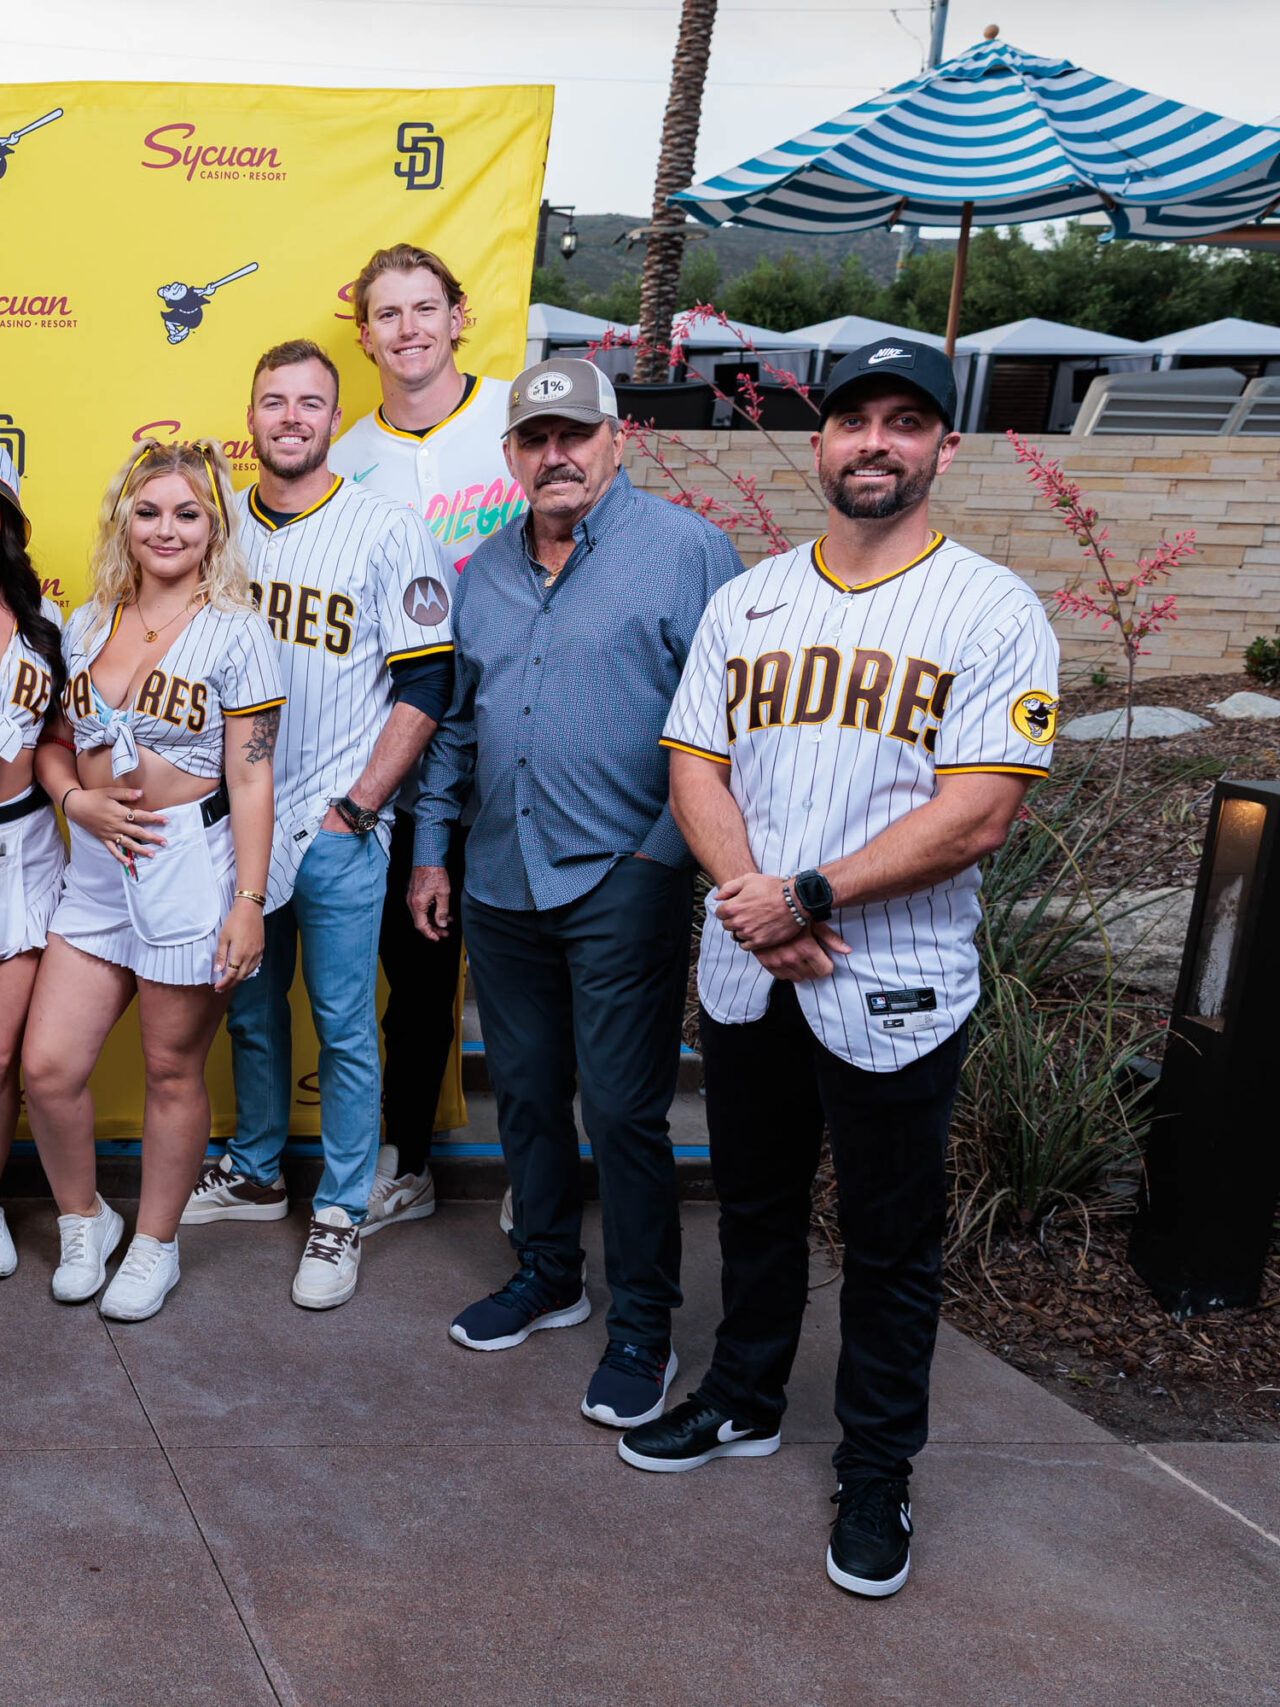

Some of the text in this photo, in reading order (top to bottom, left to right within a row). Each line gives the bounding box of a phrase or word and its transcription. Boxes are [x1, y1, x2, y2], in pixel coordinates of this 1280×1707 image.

[141, 123, 282, 182] Sycuan
[199, 170, 287, 182] CASINO RESORT
[40, 319, 78, 329] RESORT
[875, 347, 904, 358] NIKE
[232, 462, 260, 471] RESO
[62, 668, 208, 734] PARES
